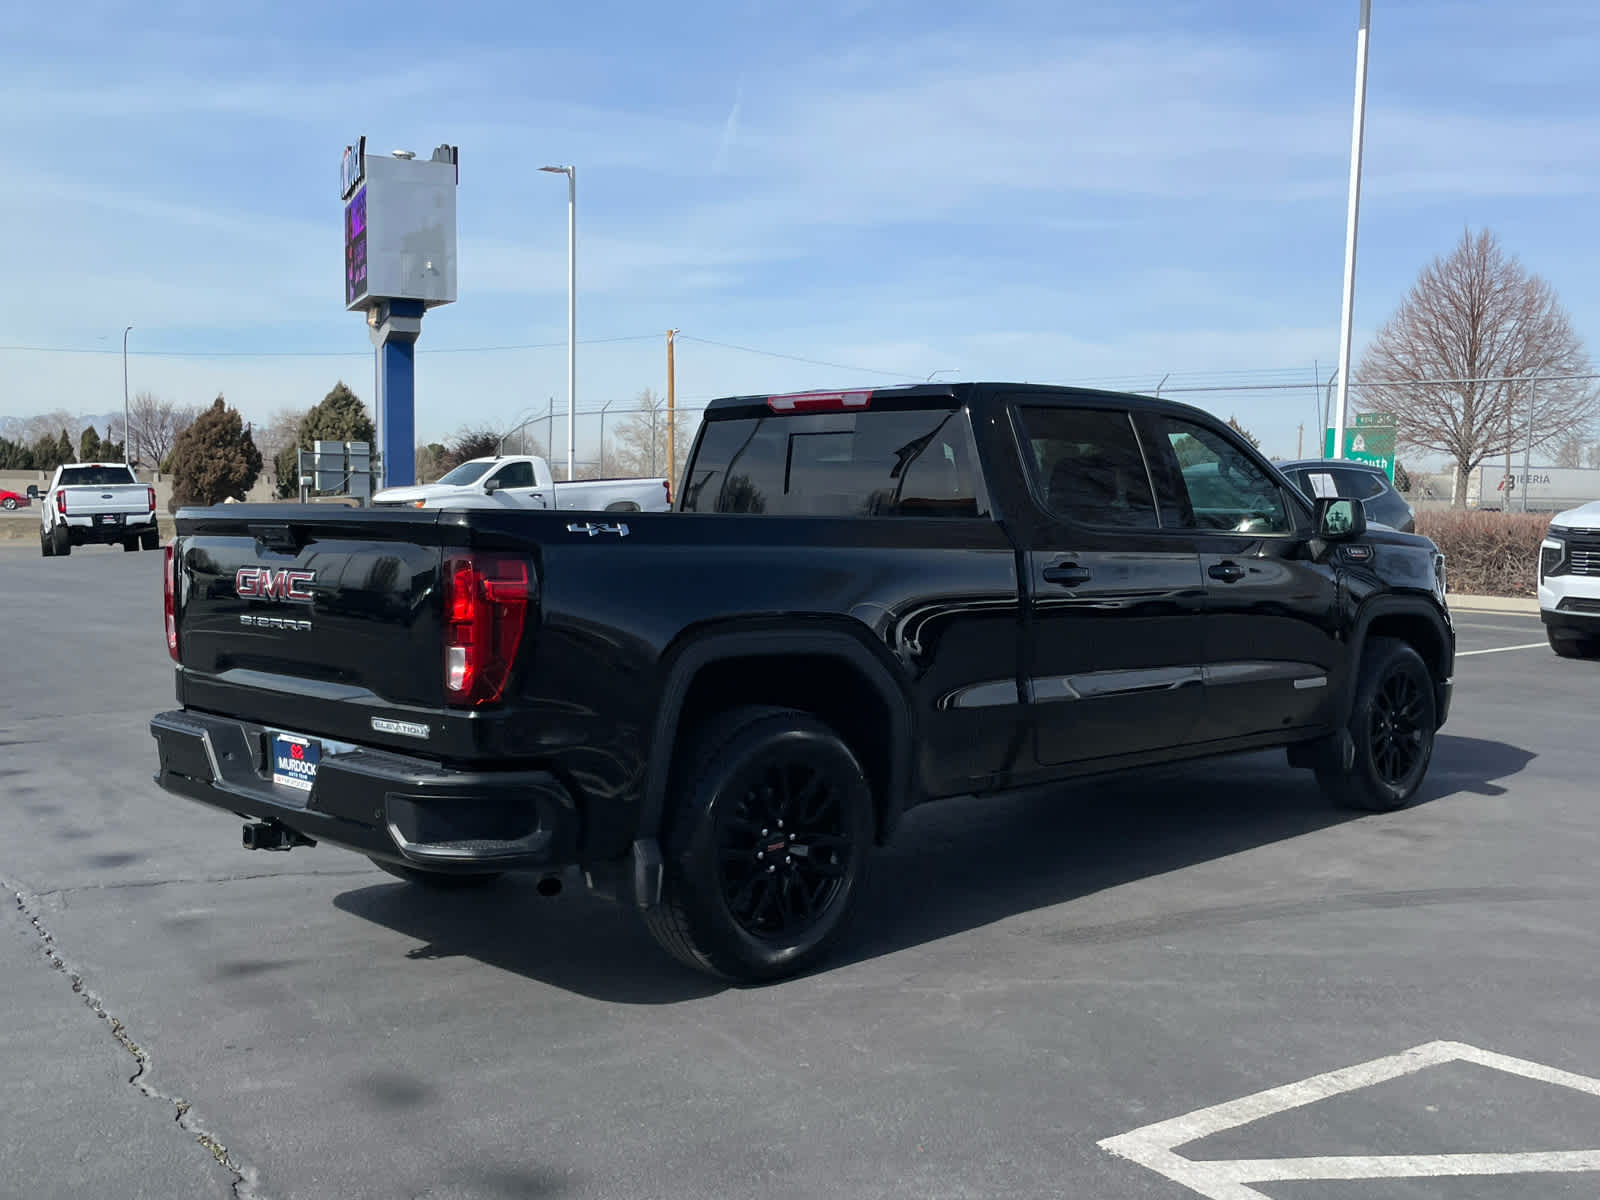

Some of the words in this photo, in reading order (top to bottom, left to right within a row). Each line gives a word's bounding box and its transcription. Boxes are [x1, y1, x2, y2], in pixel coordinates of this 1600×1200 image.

[236, 568, 315, 602] GMC
[240, 615, 312, 631] SIERRA
[373, 719, 428, 737] ELEVATION
[278, 756, 317, 776] MURDOCK
